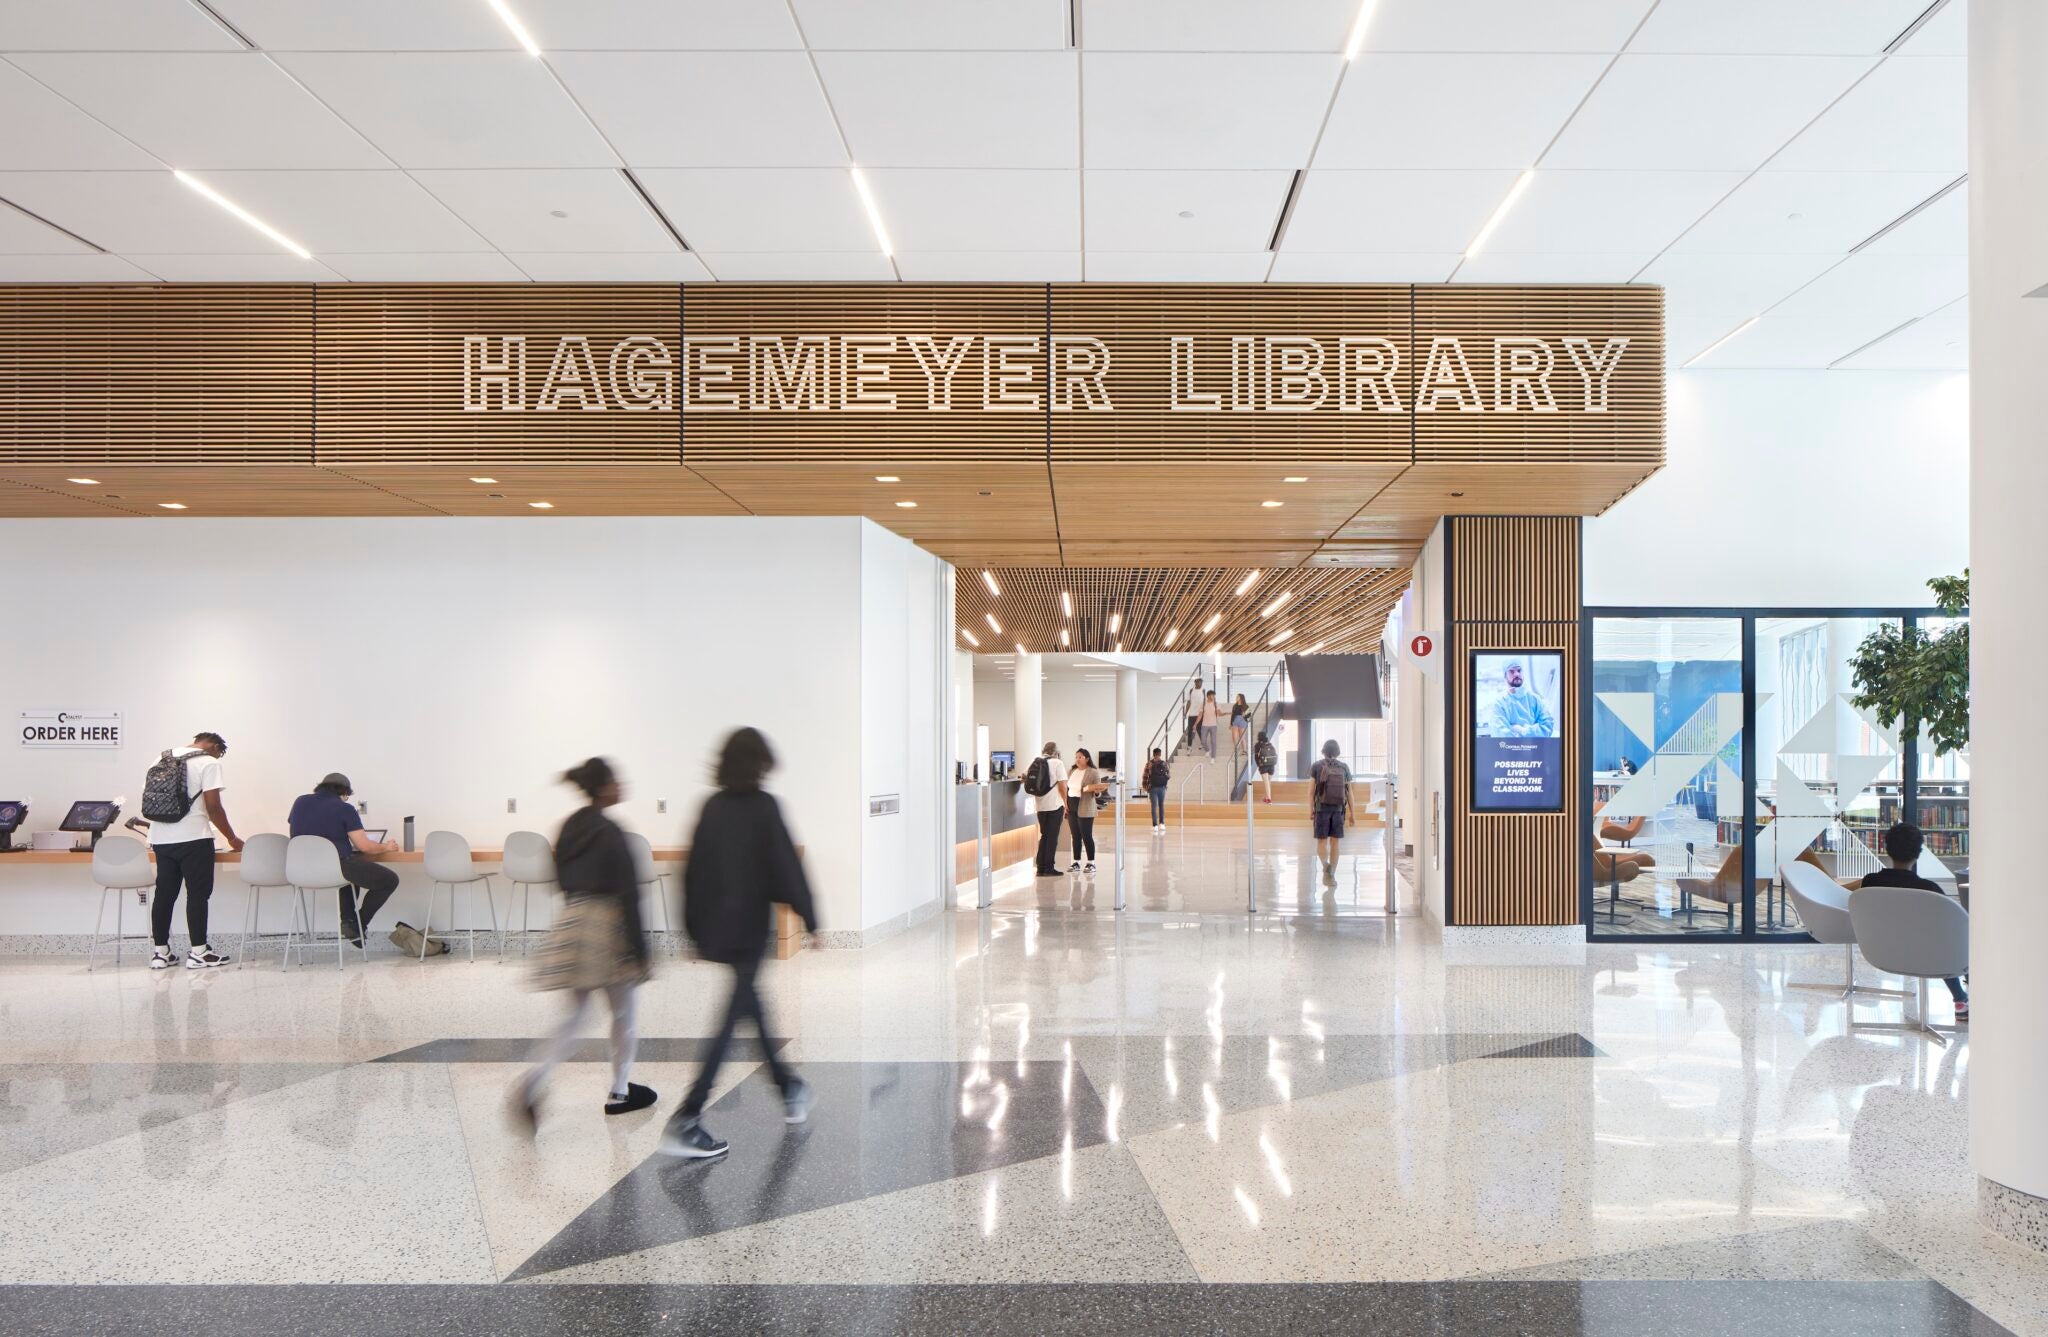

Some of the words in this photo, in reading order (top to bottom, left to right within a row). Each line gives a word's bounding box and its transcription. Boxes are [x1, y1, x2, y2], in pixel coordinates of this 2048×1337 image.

[463, 336, 1111, 411] HAGEMEYER
[1170, 336, 1631, 411] LIBRARY
[23, 726, 76, 740] ORDER
[81, 726, 118, 740] HERE
